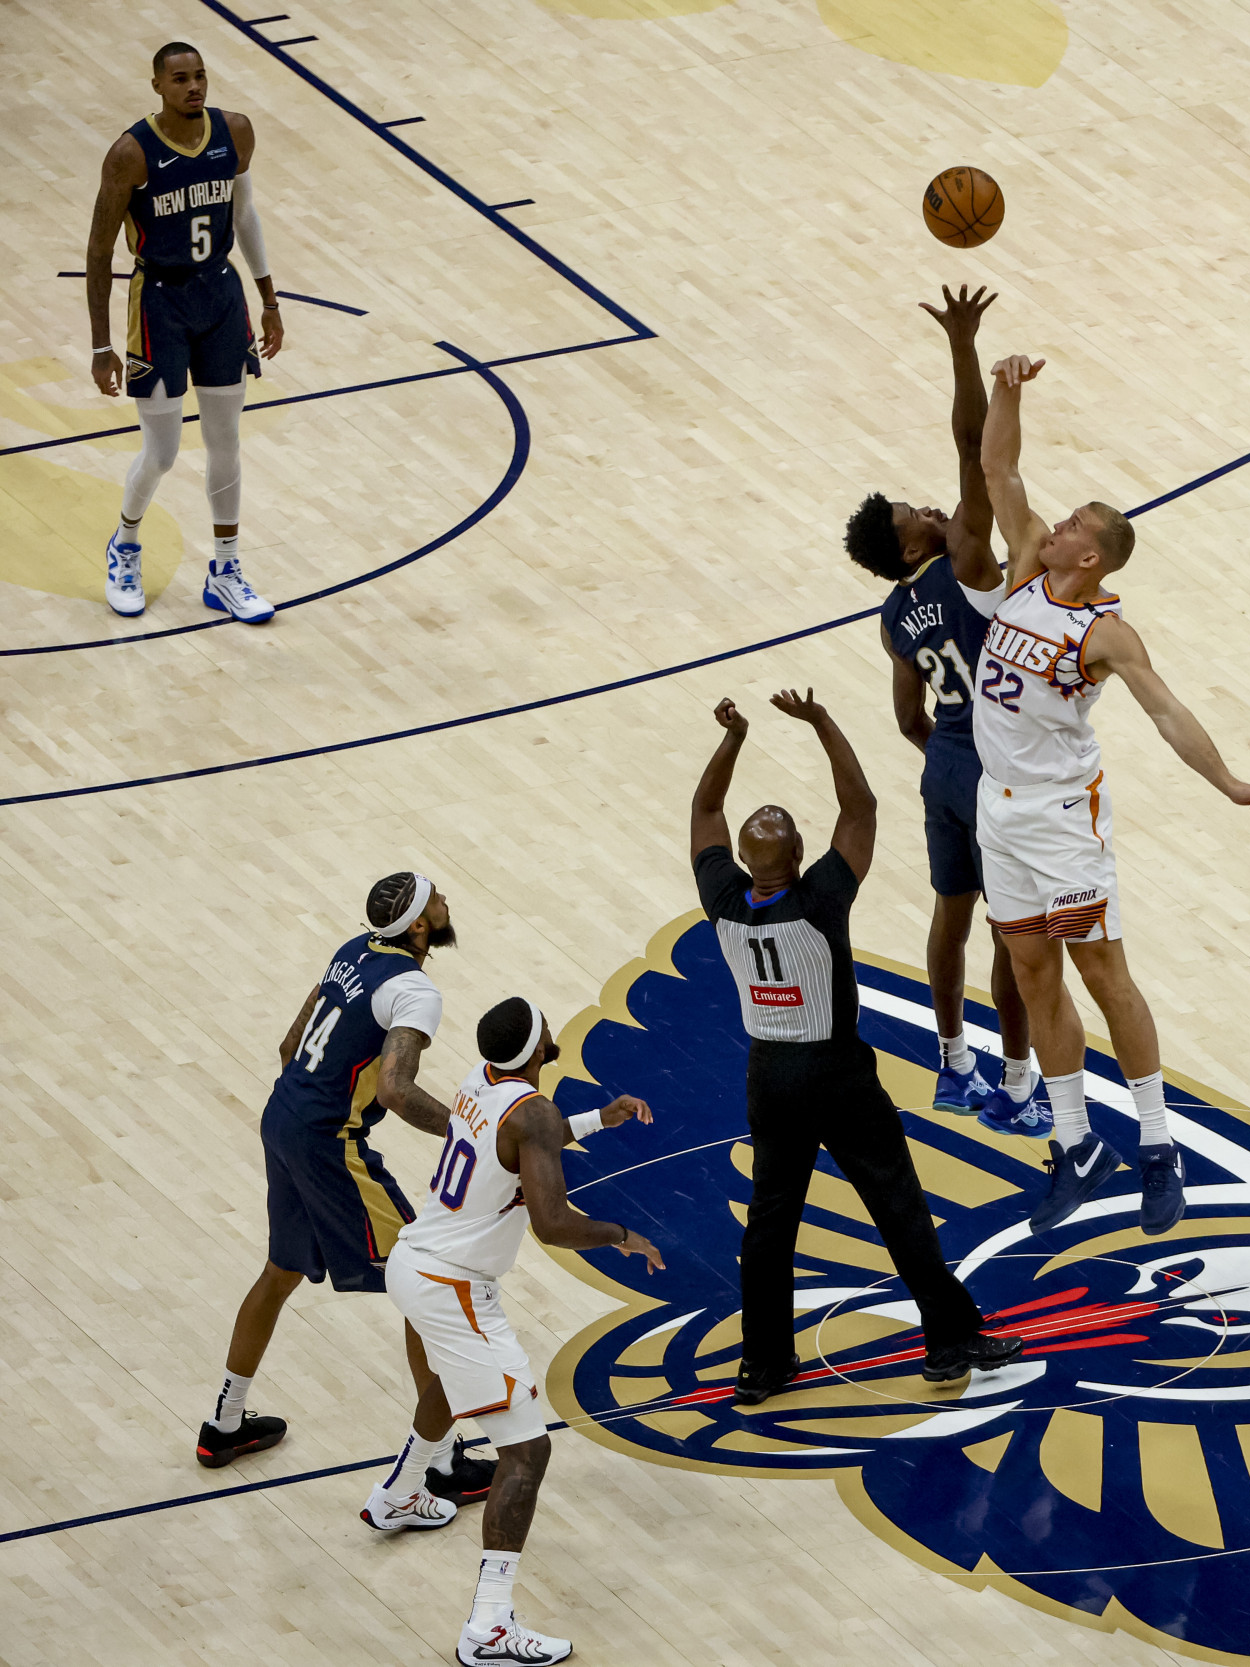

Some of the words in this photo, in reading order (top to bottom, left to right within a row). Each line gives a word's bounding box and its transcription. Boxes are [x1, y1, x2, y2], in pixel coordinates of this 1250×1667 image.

[153, 187, 186, 217] NEW
[188, 179, 235, 208] ORLEAN
[190, 215, 212, 262] 5
[900, 603, 944, 640] MISSI
[1066, 611, 1087, 629] PayPa
[985, 618, 1059, 673] SUNS
[916, 638, 975, 705] 21
[981, 659, 1025, 714] 22
[1051, 887, 1098, 908] PHOENIX
[748, 937, 784, 981] 11
[323, 960, 364, 1004] INGRAM
[753, 990, 797, 1002] Emirates
[294, 995, 342, 1074] 14
